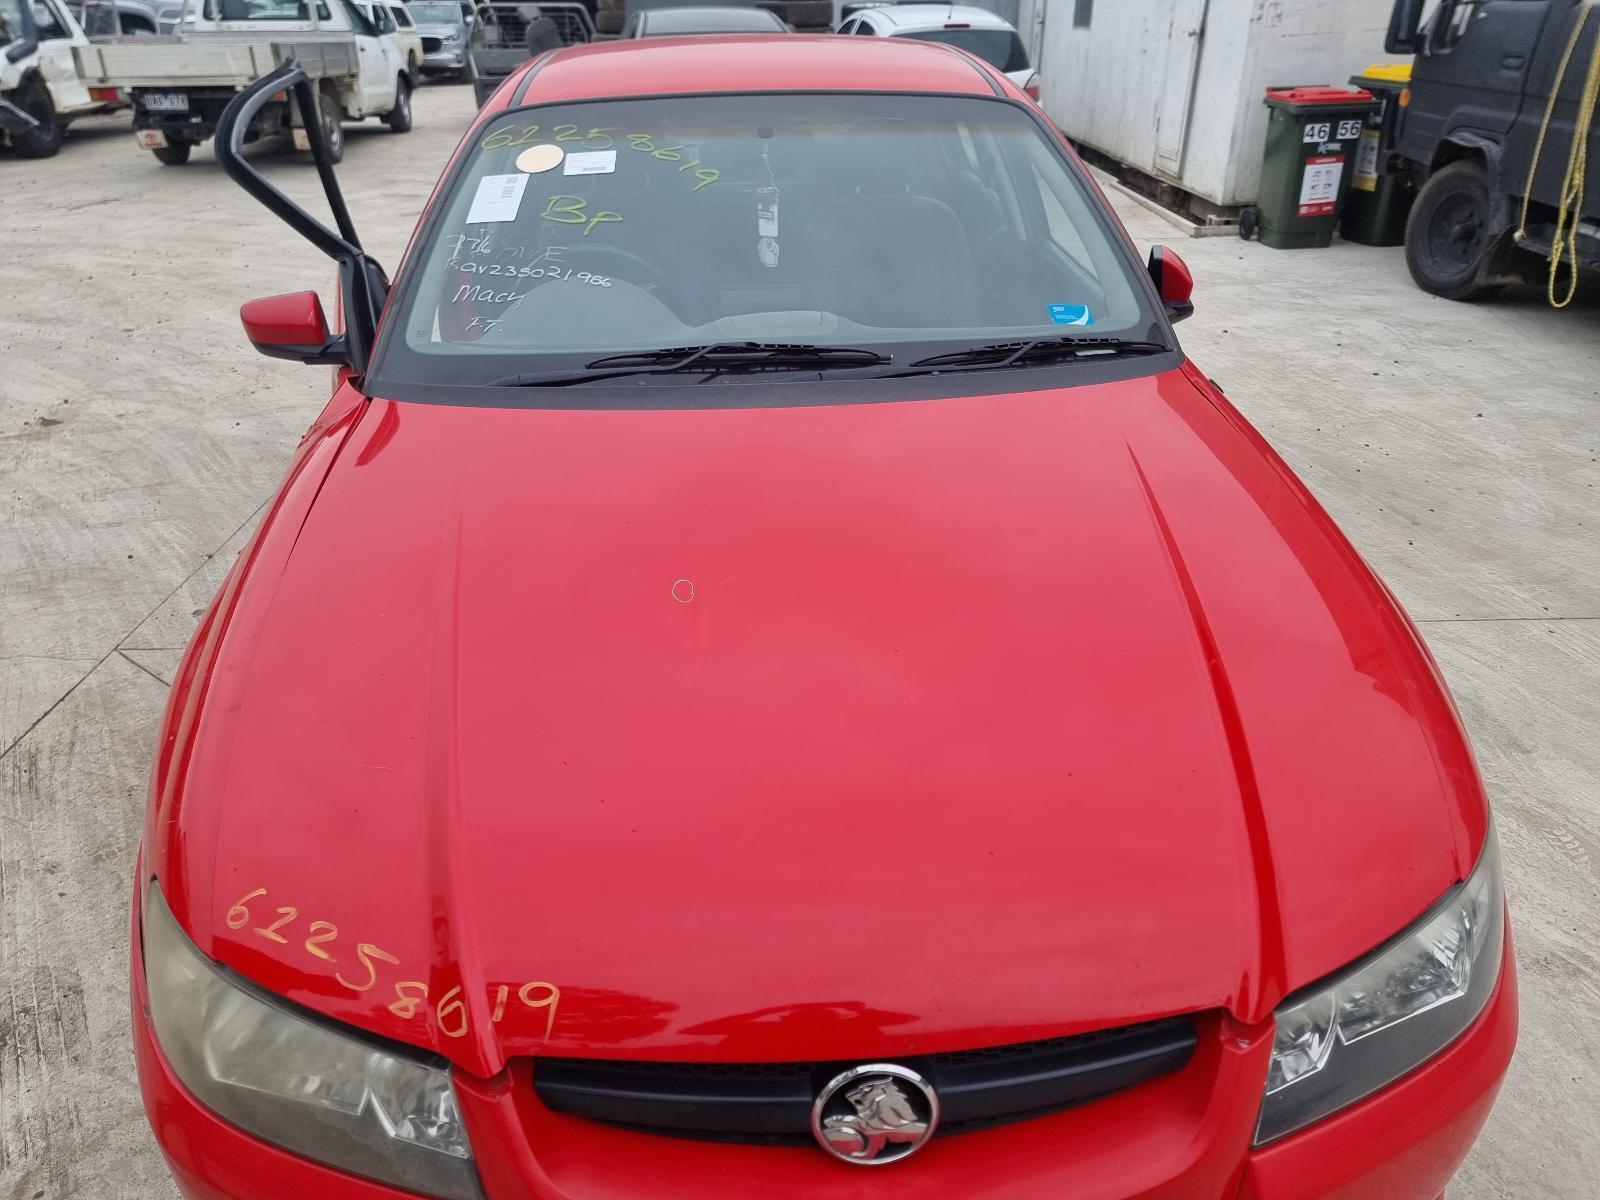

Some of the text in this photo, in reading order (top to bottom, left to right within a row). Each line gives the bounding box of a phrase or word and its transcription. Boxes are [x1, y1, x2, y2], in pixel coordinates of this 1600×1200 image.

[1304, 121, 1360, 140] 46 56
[226, 888, 560, 1044] 62258619
